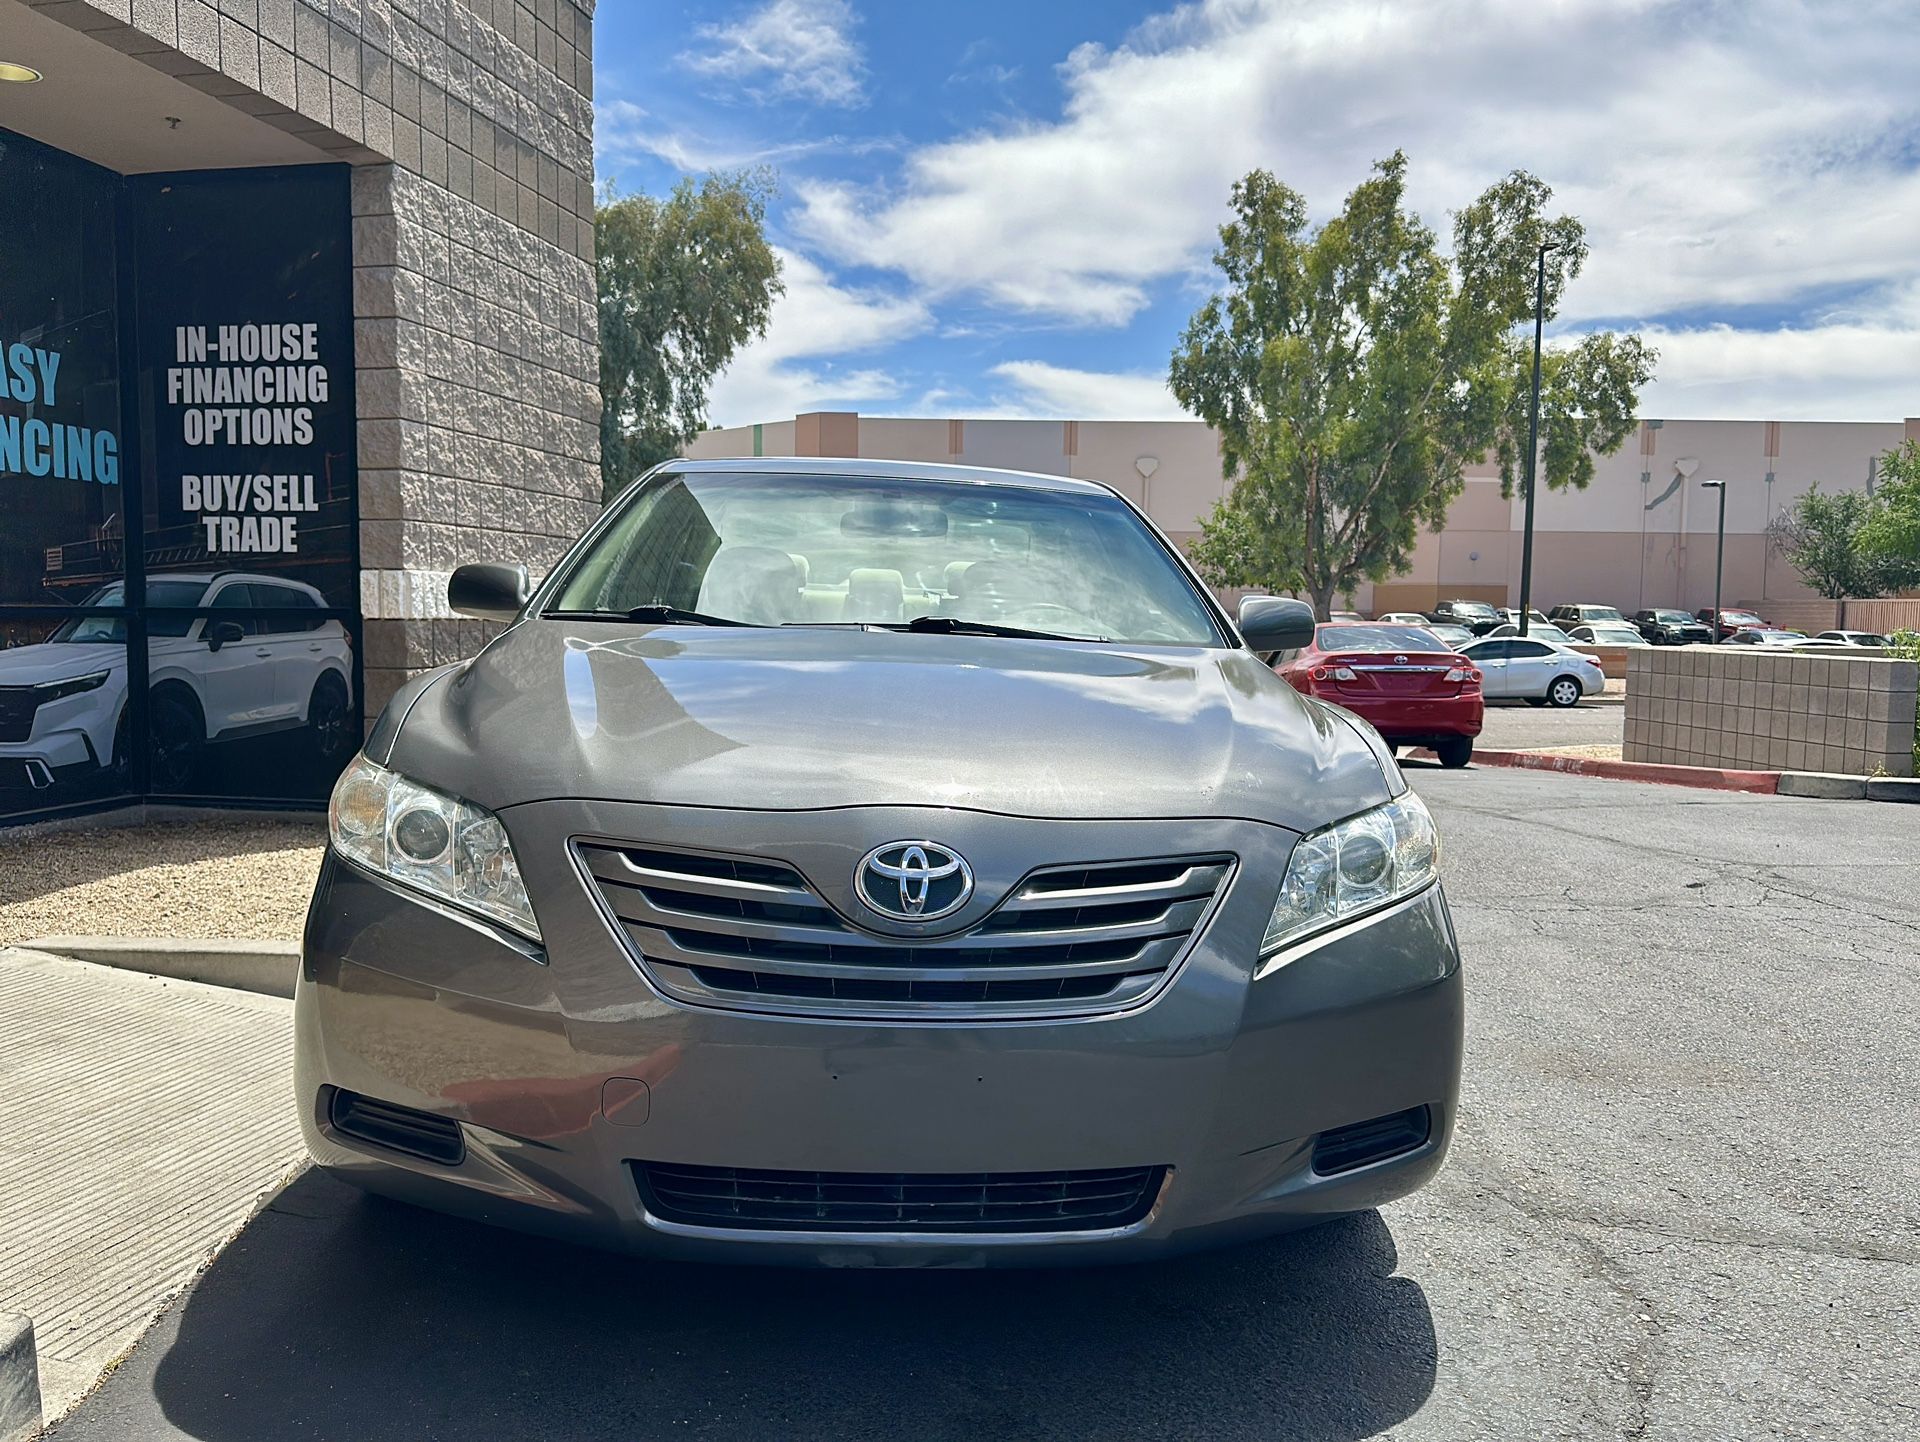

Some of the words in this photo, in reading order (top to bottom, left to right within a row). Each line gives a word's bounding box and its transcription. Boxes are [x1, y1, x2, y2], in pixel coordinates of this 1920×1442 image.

[176, 323, 319, 363] IN-HOUSE
[167, 365, 329, 404] FINANCING
[184, 407, 314, 446] OPTIONS
[182, 474, 319, 512] BUY/SELL
[202, 516, 298, 553] TRADE
